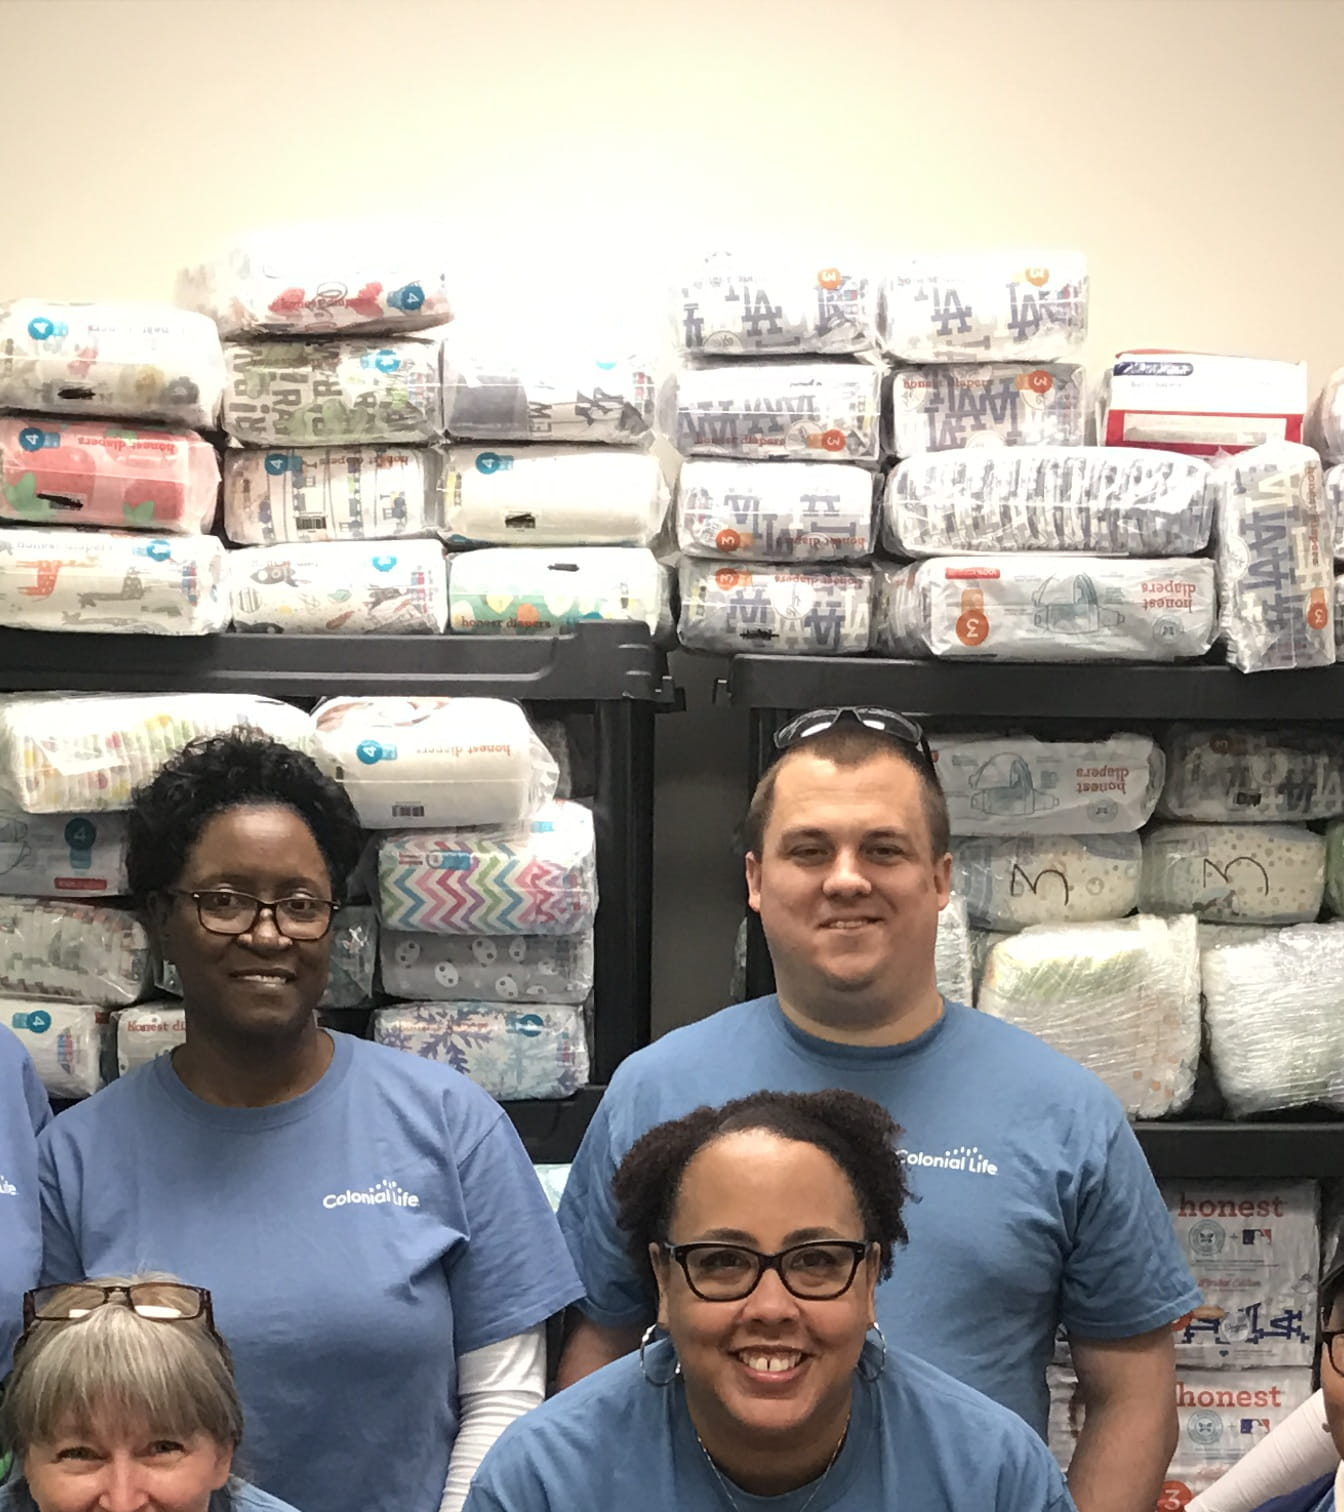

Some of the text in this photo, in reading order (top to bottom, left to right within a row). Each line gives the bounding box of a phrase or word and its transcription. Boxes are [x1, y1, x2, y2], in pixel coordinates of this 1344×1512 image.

[1141, 581, 1197, 597] diapers
[1142, 597, 1194, 613] honest
[461, 616, 502, 629] honest
[965, 619, 980, 638] 3
[465, 743, 511, 757] honest
[1076, 765, 1129, 779] diapers
[1076, 783, 1127, 795] honest
[899, 1149, 998, 1176] Colonial Life
[322, 1187, 419, 1209] Colonial Life
[1177, 1191, 1285, 1218] honest
[1176, 1381, 1282, 1408] honest
[1164, 1488, 1181, 1511] 3
